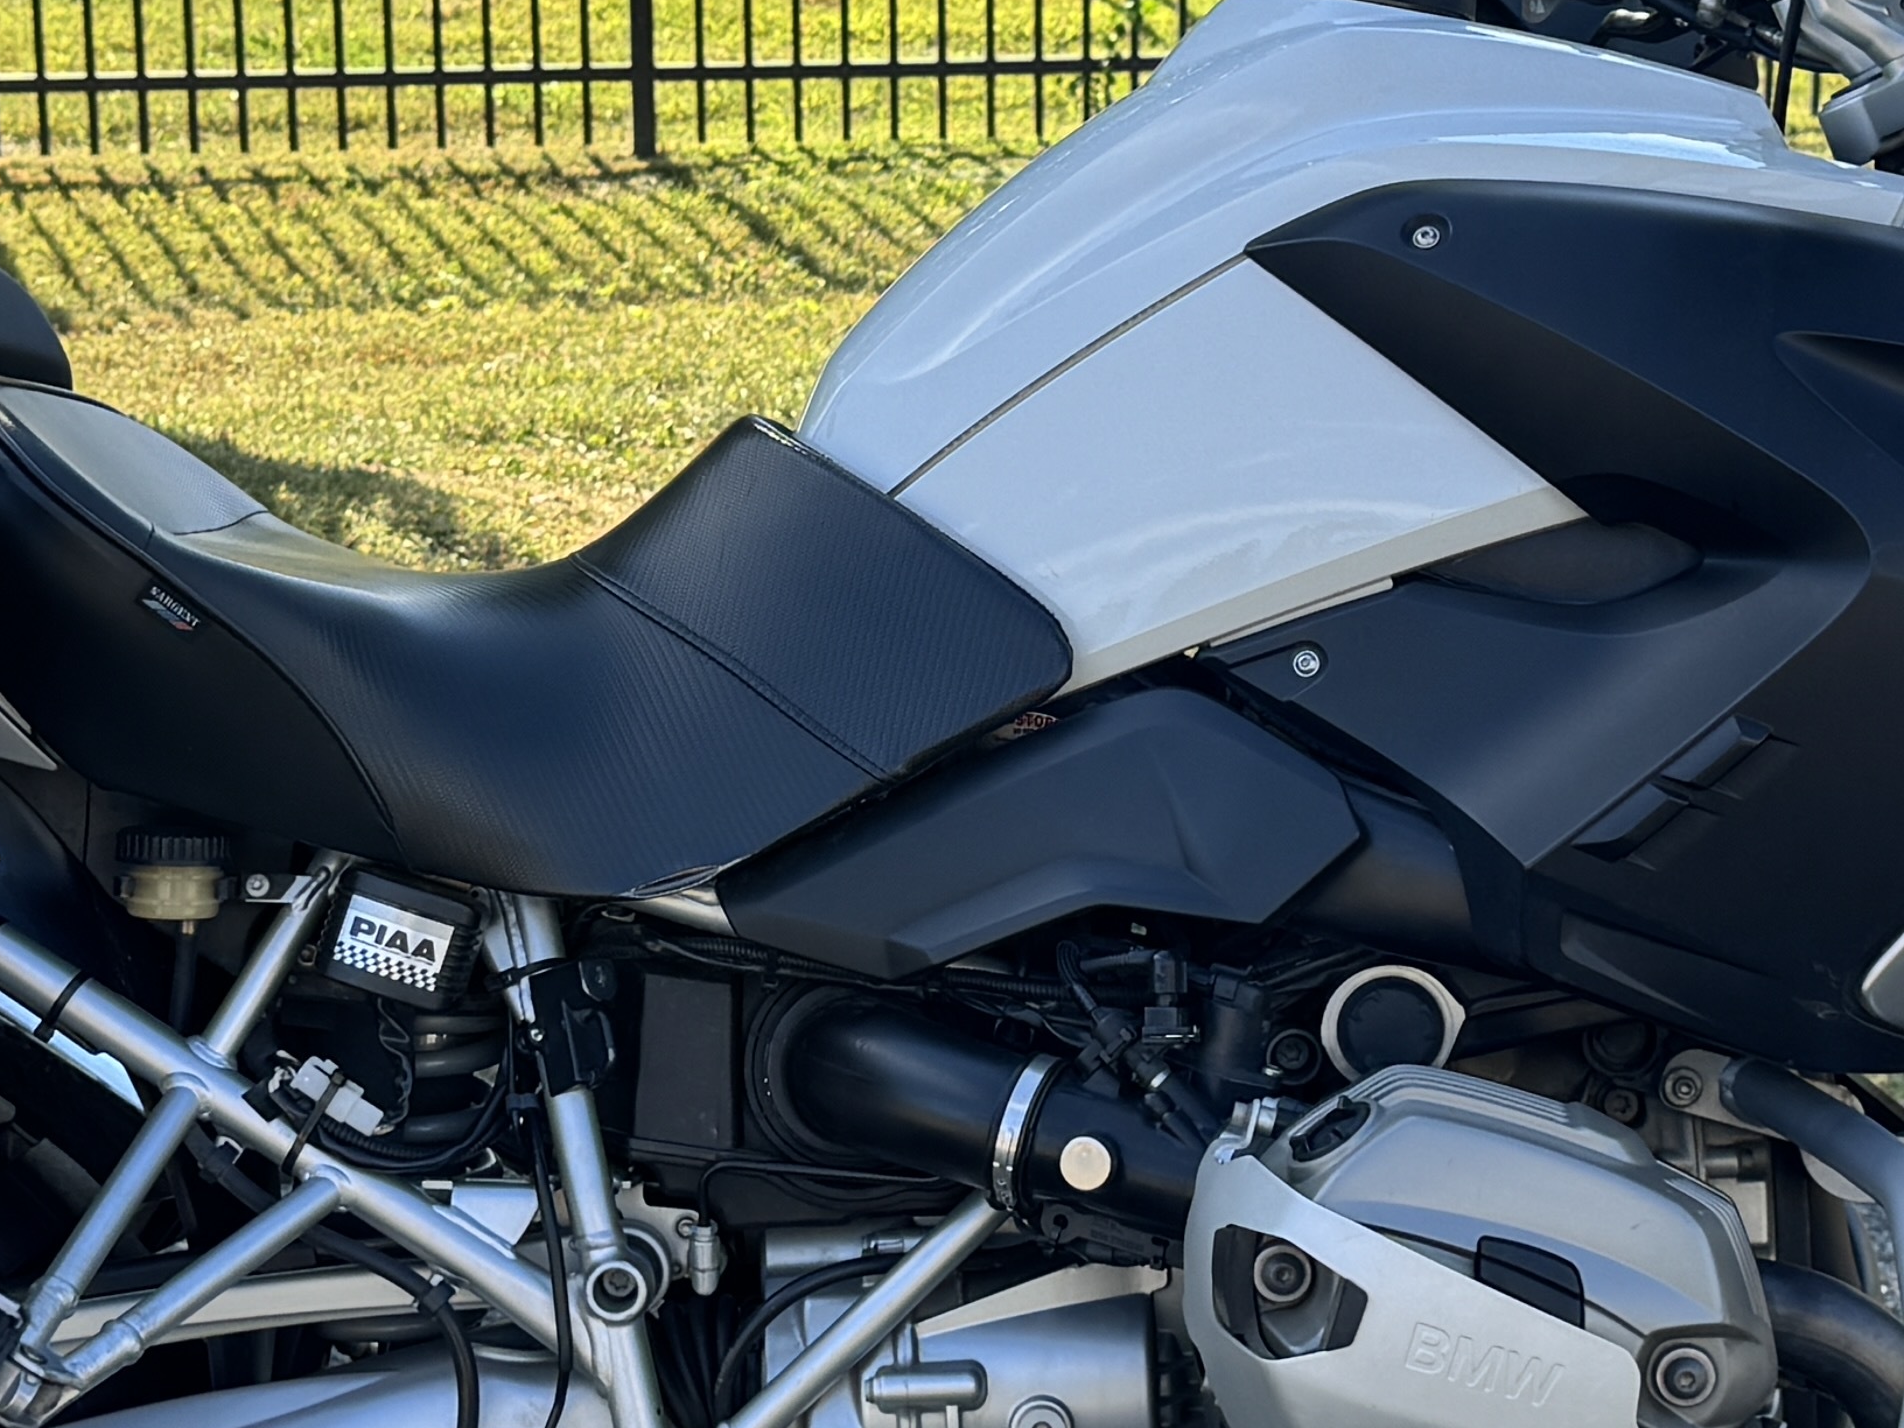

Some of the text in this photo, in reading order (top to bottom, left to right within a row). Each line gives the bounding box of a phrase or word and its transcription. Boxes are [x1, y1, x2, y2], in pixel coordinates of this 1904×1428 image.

[150, 585, 201, 627] SARGENT
[349, 915, 436, 963] PIAA
[1405, 1322, 1566, 1407] BMW
